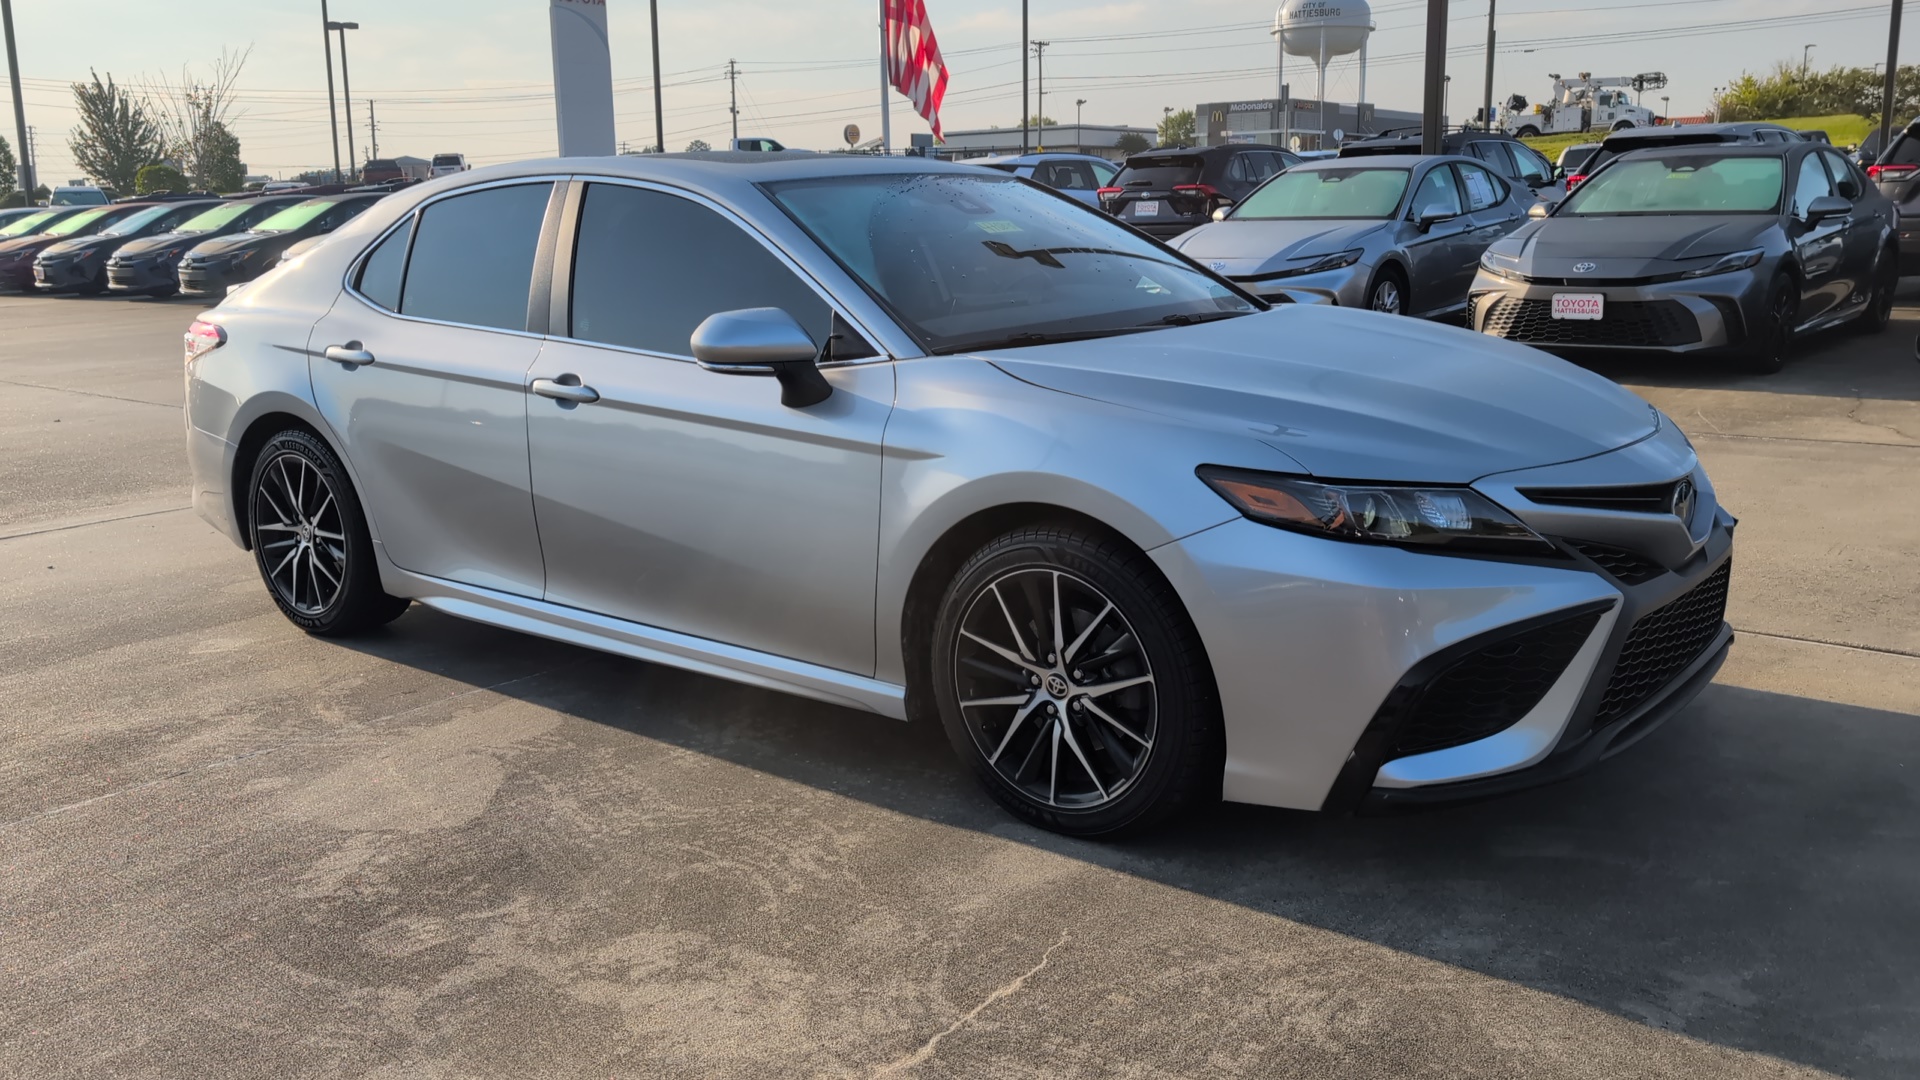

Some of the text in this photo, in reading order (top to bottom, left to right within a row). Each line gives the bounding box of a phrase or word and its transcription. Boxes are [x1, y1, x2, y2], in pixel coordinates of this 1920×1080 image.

[1289, 8, 1341, 19] HATTIESBURG
[1230, 102, 1273, 112] McDonald's
[1555, 299, 1599, 308] TOYOTA
[1554, 307, 1600, 315] HATTIESBURG
[284, 440, 322, 466] ASSURANCE
